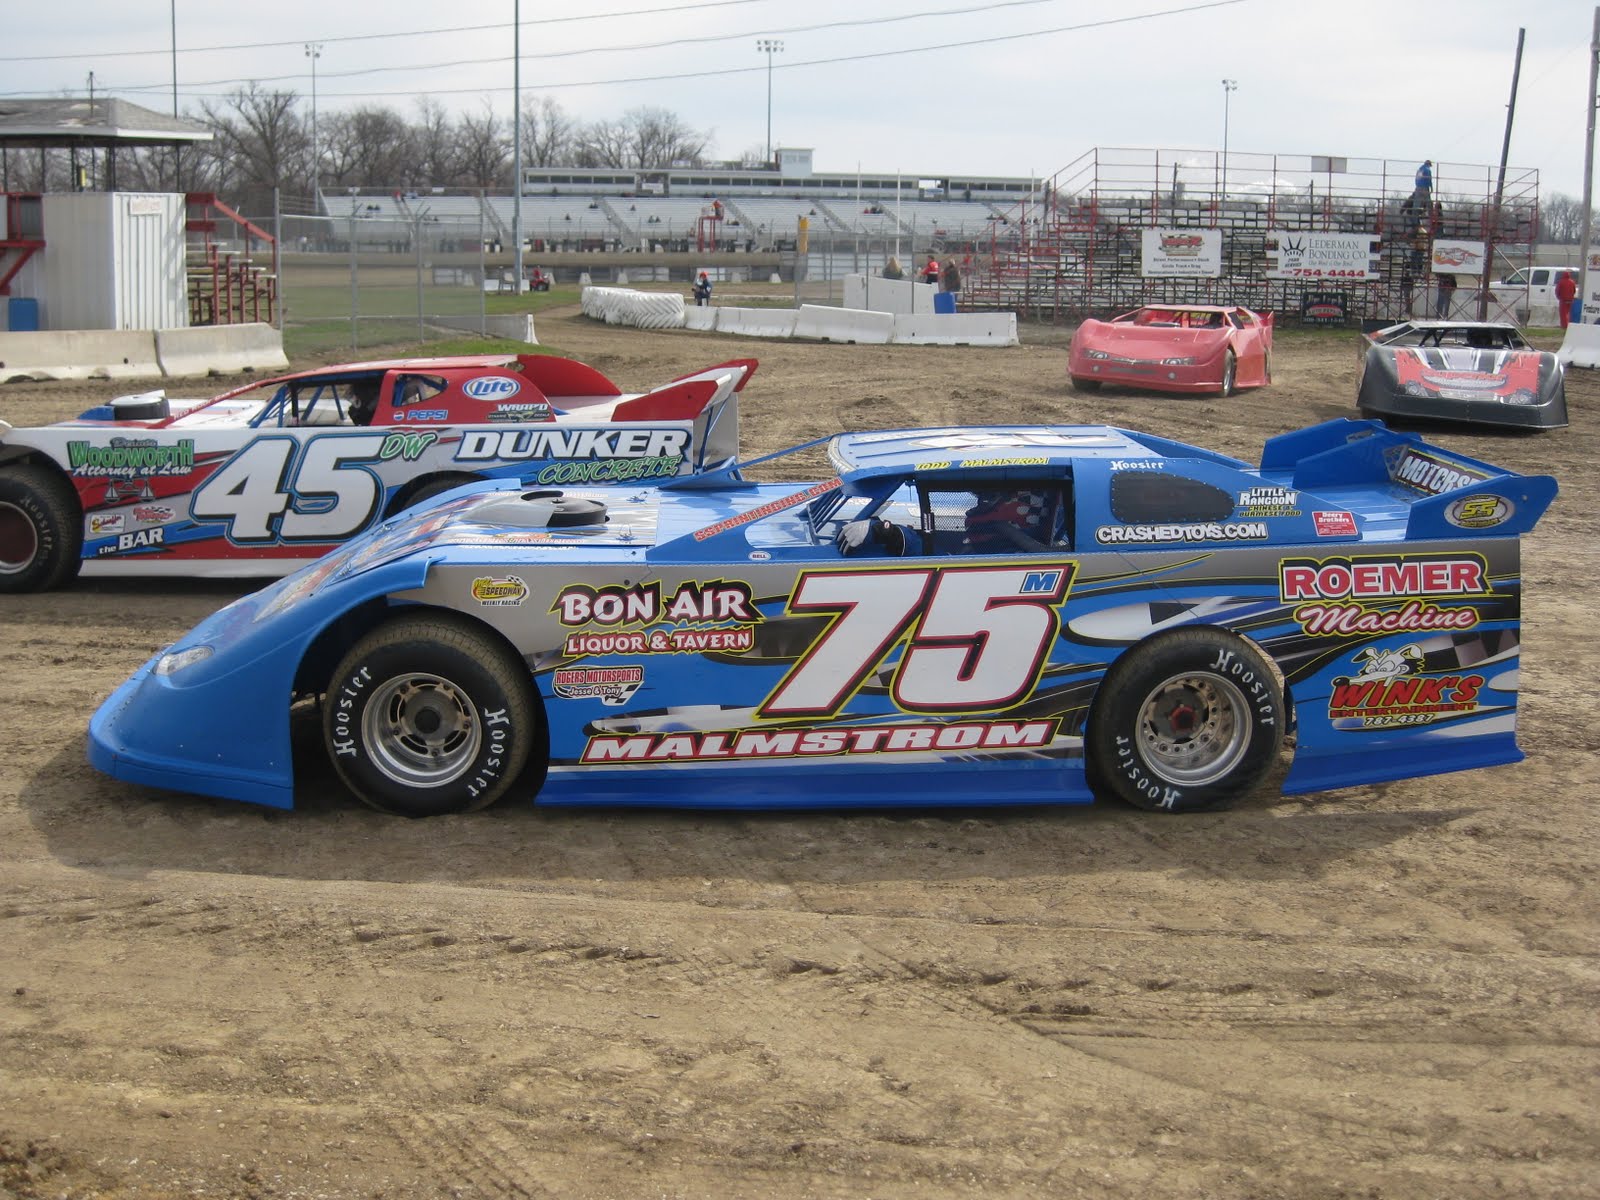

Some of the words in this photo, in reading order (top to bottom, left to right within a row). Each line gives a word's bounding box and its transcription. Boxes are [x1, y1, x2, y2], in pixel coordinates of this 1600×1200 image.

[1309, 239, 1359, 249] LEDERMAN
[1309, 249, 1350, 260] BONDING
[1293, 268, 1365, 277] 754-4444
[472, 380, 512, 396] Lite
[407, 410, 449, 420] PEPSI
[68, 439, 194, 468] WOODWORTH
[380, 433, 435, 459] DW
[456, 431, 688, 459] DUNKER
[73, 462, 136, 478] Attorney
[140, 466, 156, 474] at
[157, 461, 191, 475] Law
[538, 455, 682, 483] CONCRETE
[915, 461, 952, 470] TODD
[960, 457, 1050, 467] MALMSTROM
[1110, 460, 1164, 470] Hoosier
[192, 434, 384, 544] 45
[1240, 492, 1296, 506] RANGOON
[1252, 488, 1284, 497] LITTLE
[99, 545, 116, 554] the
[119, 527, 163, 550] BAR
[1097, 521, 1268, 542] CRASHEDTOYS.COM
[1025, 571, 1058, 593] M
[1283, 560, 1484, 599] ROEMER
[484, 586, 522, 596] SPEEDWAY
[561, 591, 653, 621] BON
[670, 590, 748, 620] AIR
[1300, 600, 1476, 632] Machine
[568, 635, 644, 653] LIQUOR
[651, 633, 667, 650] &
[673, 631, 750, 649] TAVERN
[765, 568, 1072, 712] 75
[556, 670, 585, 684] ROGERS
[586, 668, 641, 683] MOTORSPORTS
[1209, 647, 1275, 726] Hoosier
[568, 686, 592, 696] Jesse
[593, 686, 601, 695] &
[602, 685, 621, 697] Tony
[1329, 676, 1485, 709] WINK'S
[333, 666, 372, 758] Hoosier
[1329, 702, 1477, 718] ENTERTAINMENT
[1364, 713, 1437, 727] 787-4387
[467, 707, 511, 797] Hoosier
[585, 721, 1052, 762] MALMSTROM
[1115, 736, 1184, 810] Hoosier
